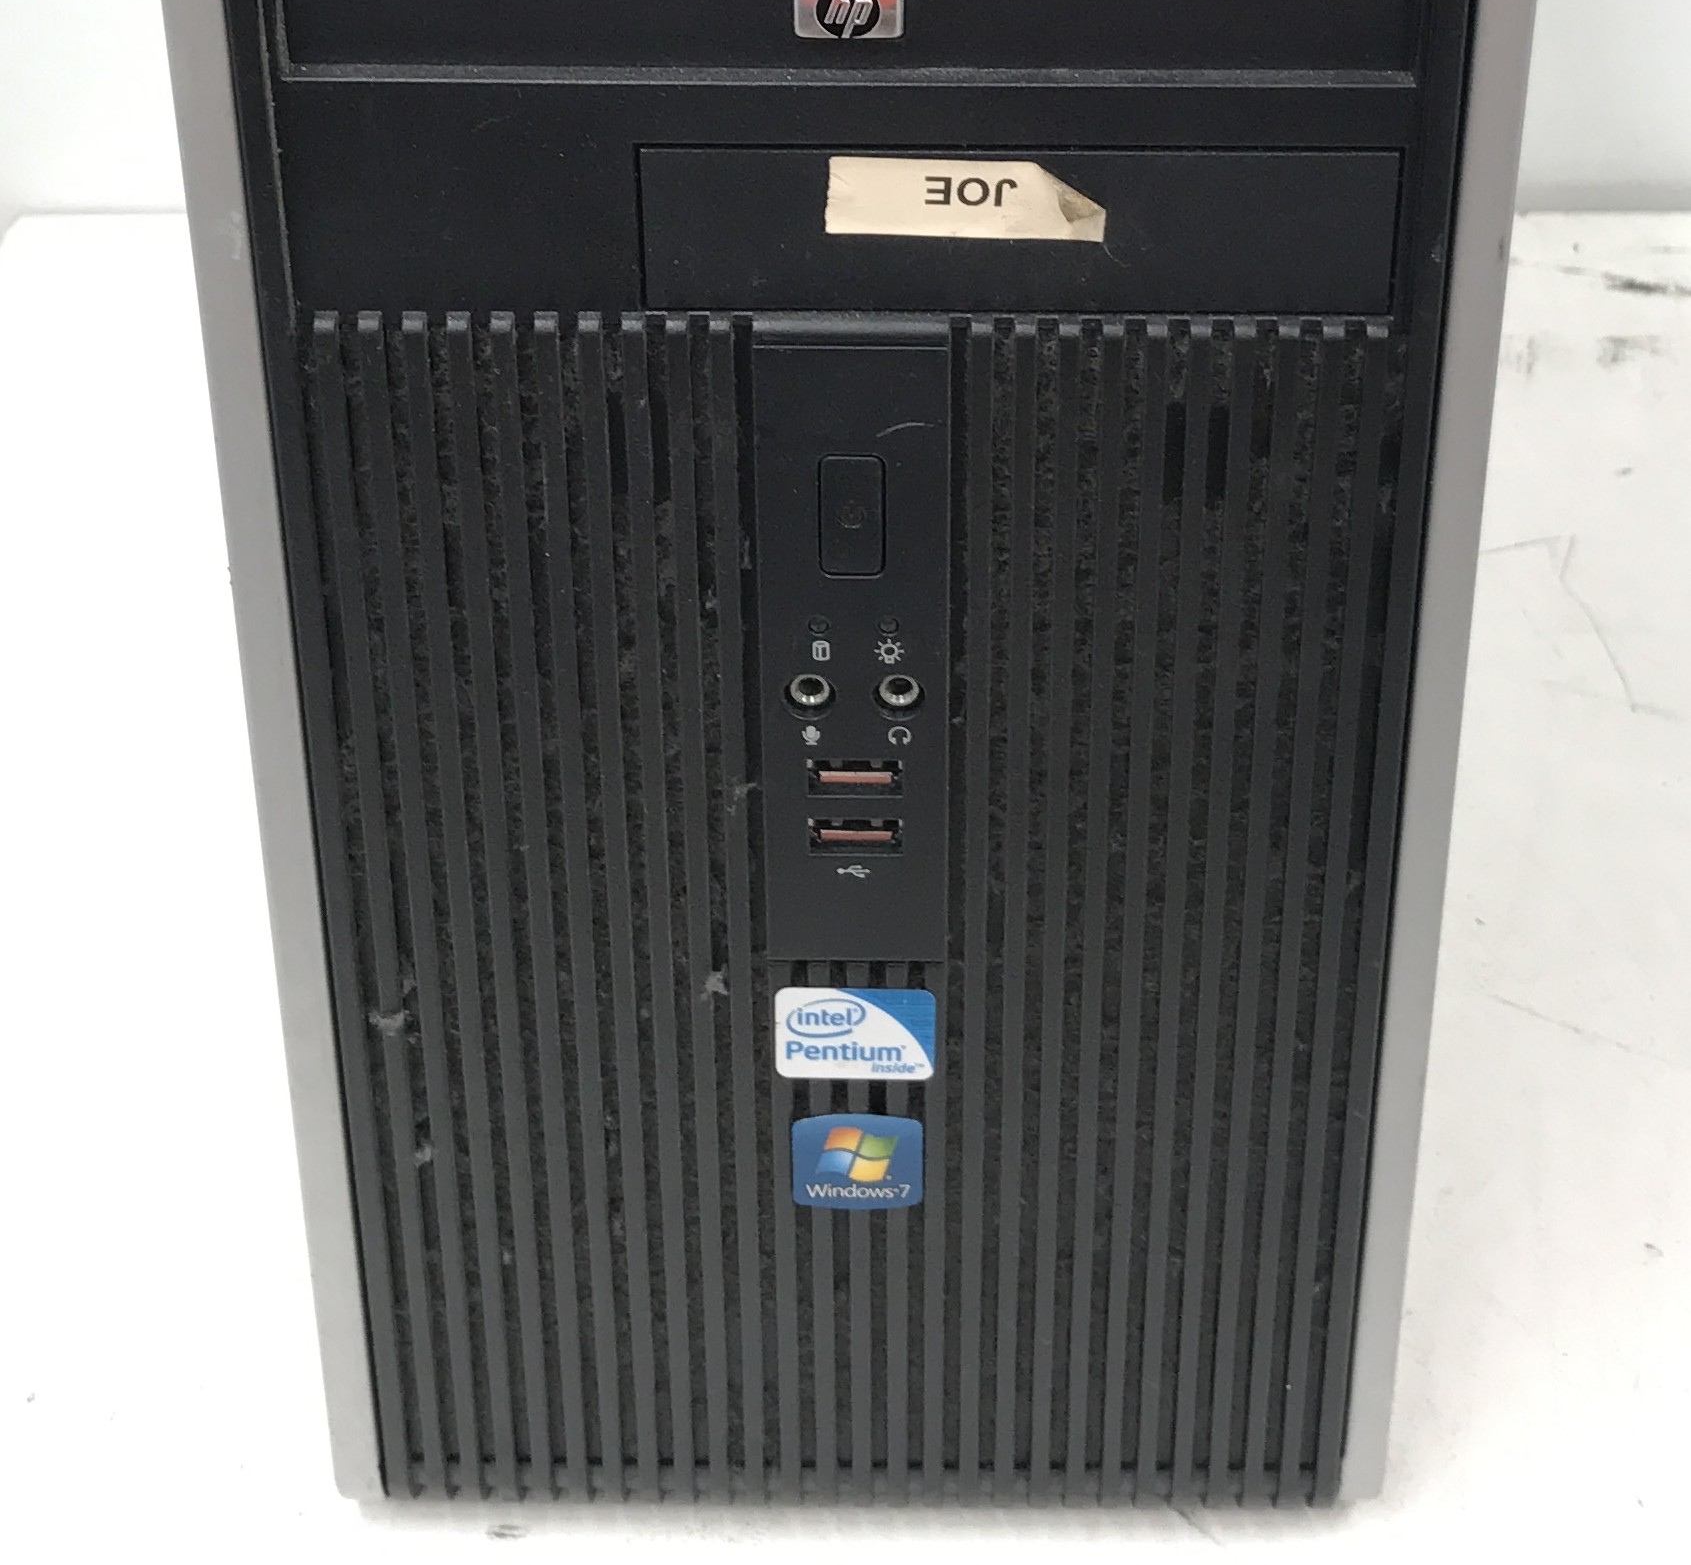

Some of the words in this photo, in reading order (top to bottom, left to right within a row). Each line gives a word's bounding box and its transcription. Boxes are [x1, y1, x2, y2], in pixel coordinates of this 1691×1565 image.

[924, 176, 1018, 207] JOE
[786, 1040, 903, 1061] Pentium
[805, 1183, 897, 1199] Windows
[899, 1184, 911, 1199] 7
